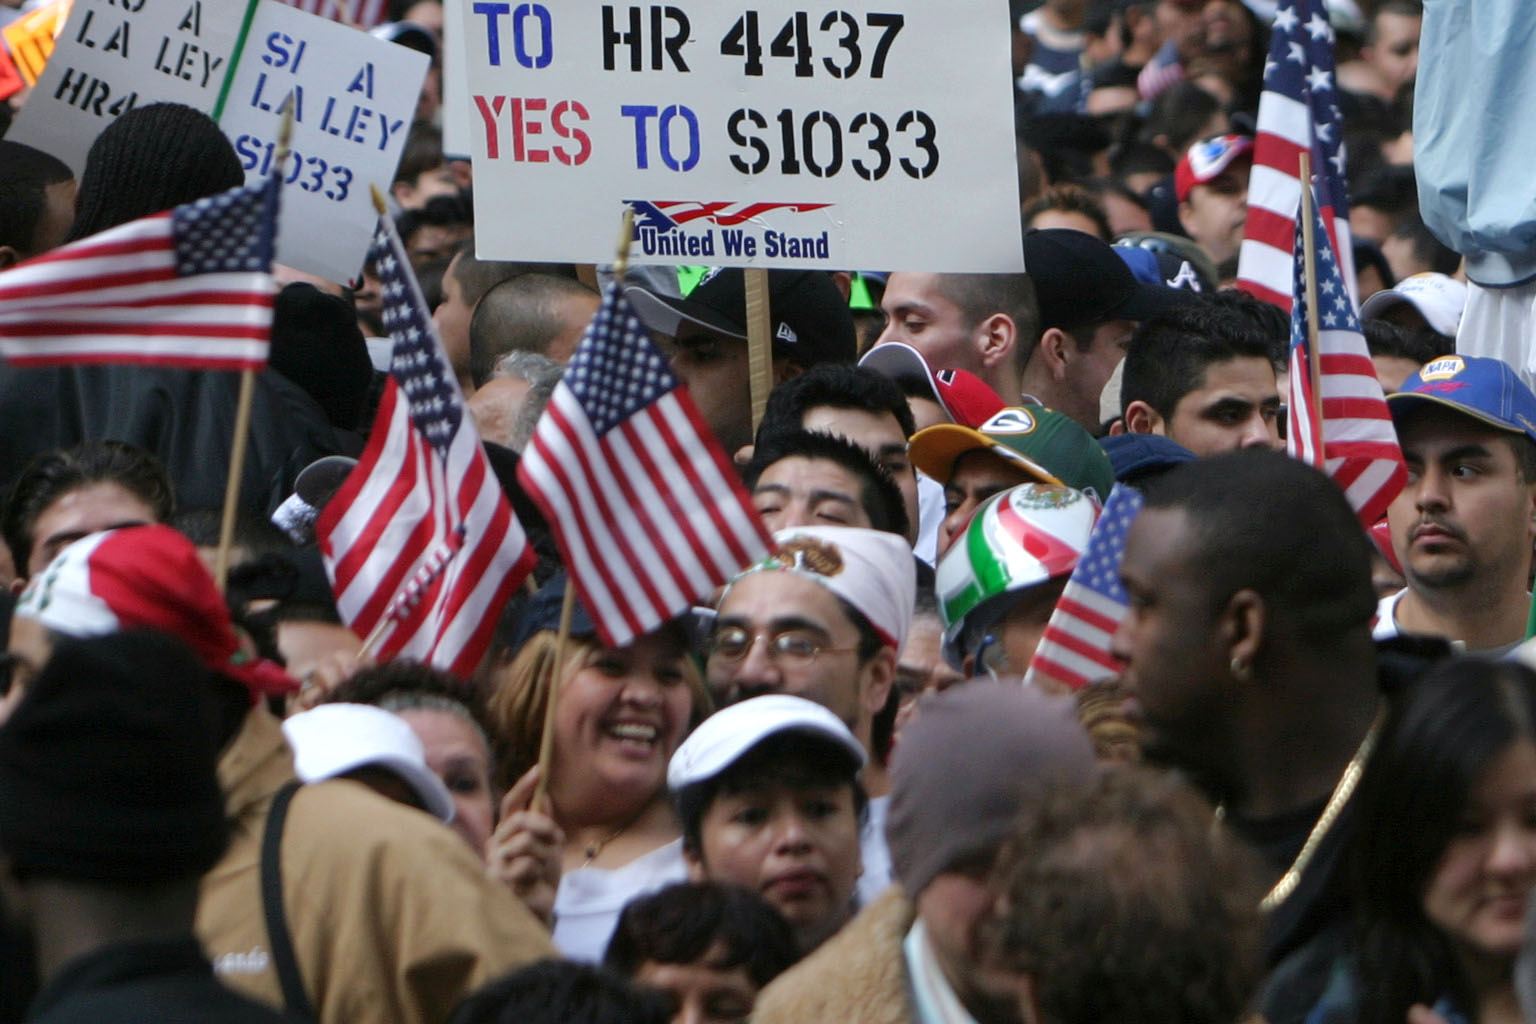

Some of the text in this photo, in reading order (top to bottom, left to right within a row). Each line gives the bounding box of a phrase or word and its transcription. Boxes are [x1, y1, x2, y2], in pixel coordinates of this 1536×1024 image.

[178, 0, 202, 37] A
[473, 2, 905, 80] TO HR 4437
[74, 10, 131, 59] LA
[153, 36, 225, 88] LEY
[261, 31, 375, 100] SI A
[53, 66, 141, 118] HR4
[250, 73, 404, 152] LA LEY
[472, 94, 940, 182] YES TO S1033
[639, 227, 831, 260] United We Stand
[1166, 260, 1202, 293] A
[1427, 360, 1457, 375] NAPA
